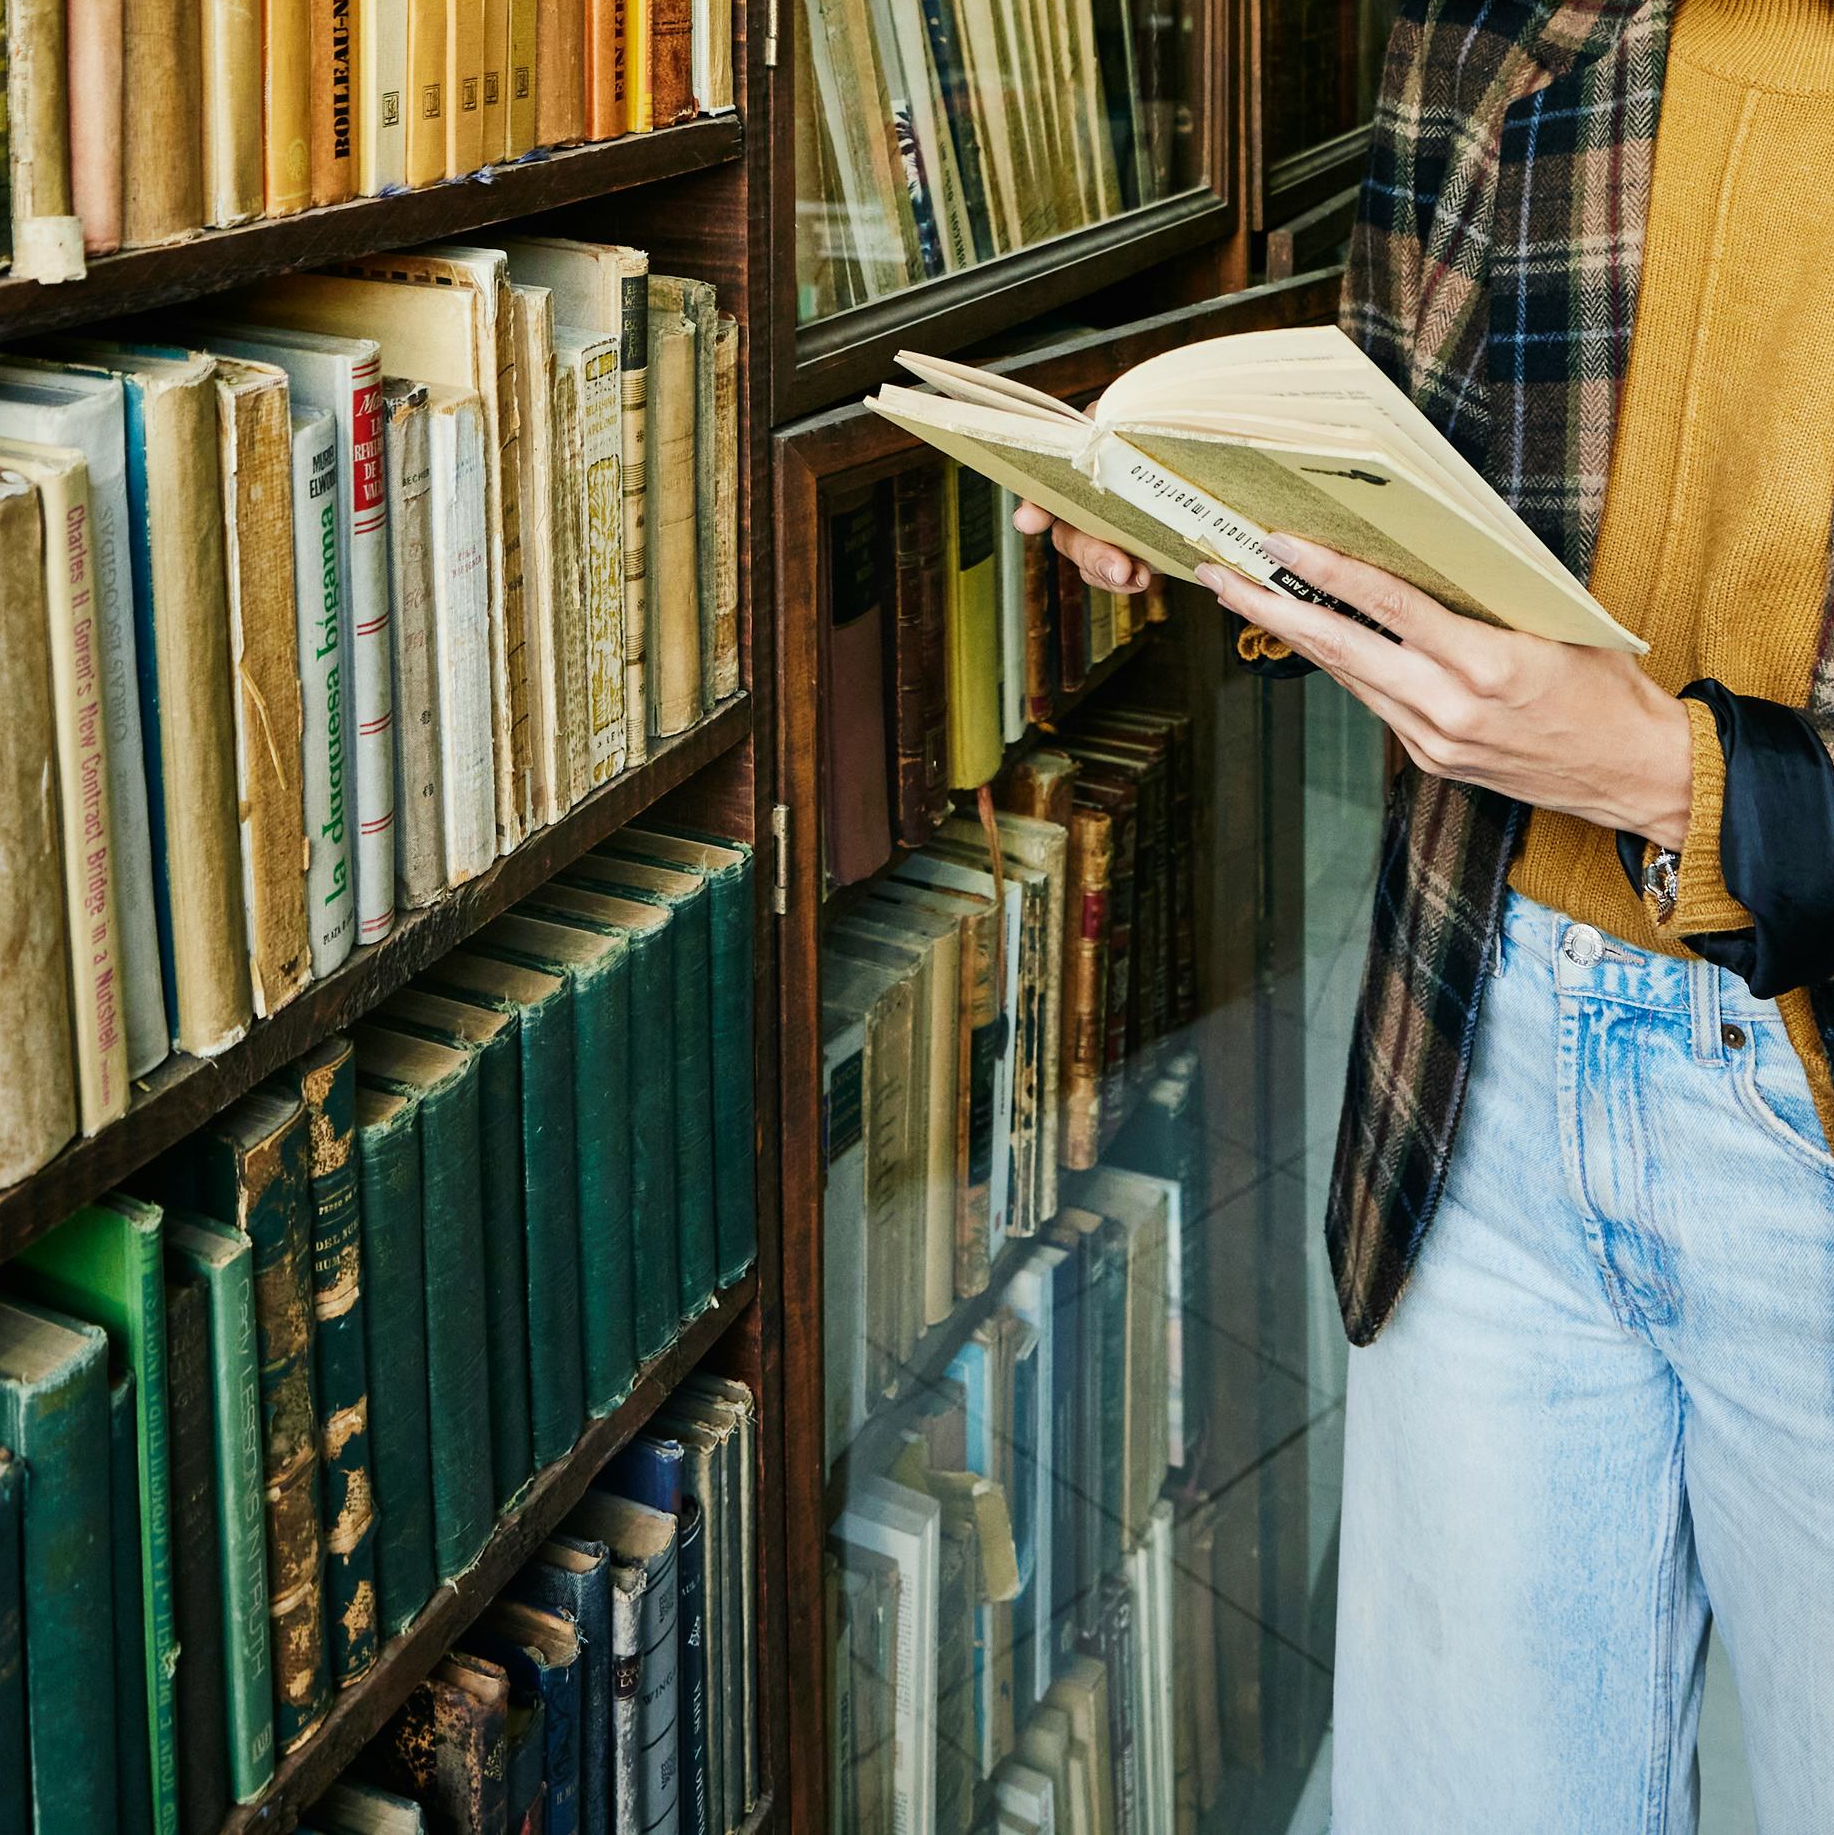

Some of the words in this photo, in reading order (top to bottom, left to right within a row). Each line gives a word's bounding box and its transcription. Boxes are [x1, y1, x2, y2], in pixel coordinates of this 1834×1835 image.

[364, 461, 377, 481] DE
[1130, 465, 1212, 522] imperfecto
[65, 505, 89, 590] Charles
[70, 593, 89, 615] H.
[313, 502, 337, 662] bígama
[1281, 572, 1312, 598] FAIR
[73, 620, 96, 698] Goren's
[76, 703, 100, 749] New
[320, 663, 347, 847] duquesa
[79, 755, 107, 843] Contract
[85, 848, 114, 918] Bridge
[324, 868, 347, 907] la
[93, 924, 112, 943] in
[95, 949, 108, 960] a
[96, 967, 120, 1052] Nutshell
[314, 1236, 339, 1255] DEL
[239, 1365, 263, 1519] LESSONS
[249, 1525, 265, 1546] IN
[247, 1551, 267, 1680] TRUTH
